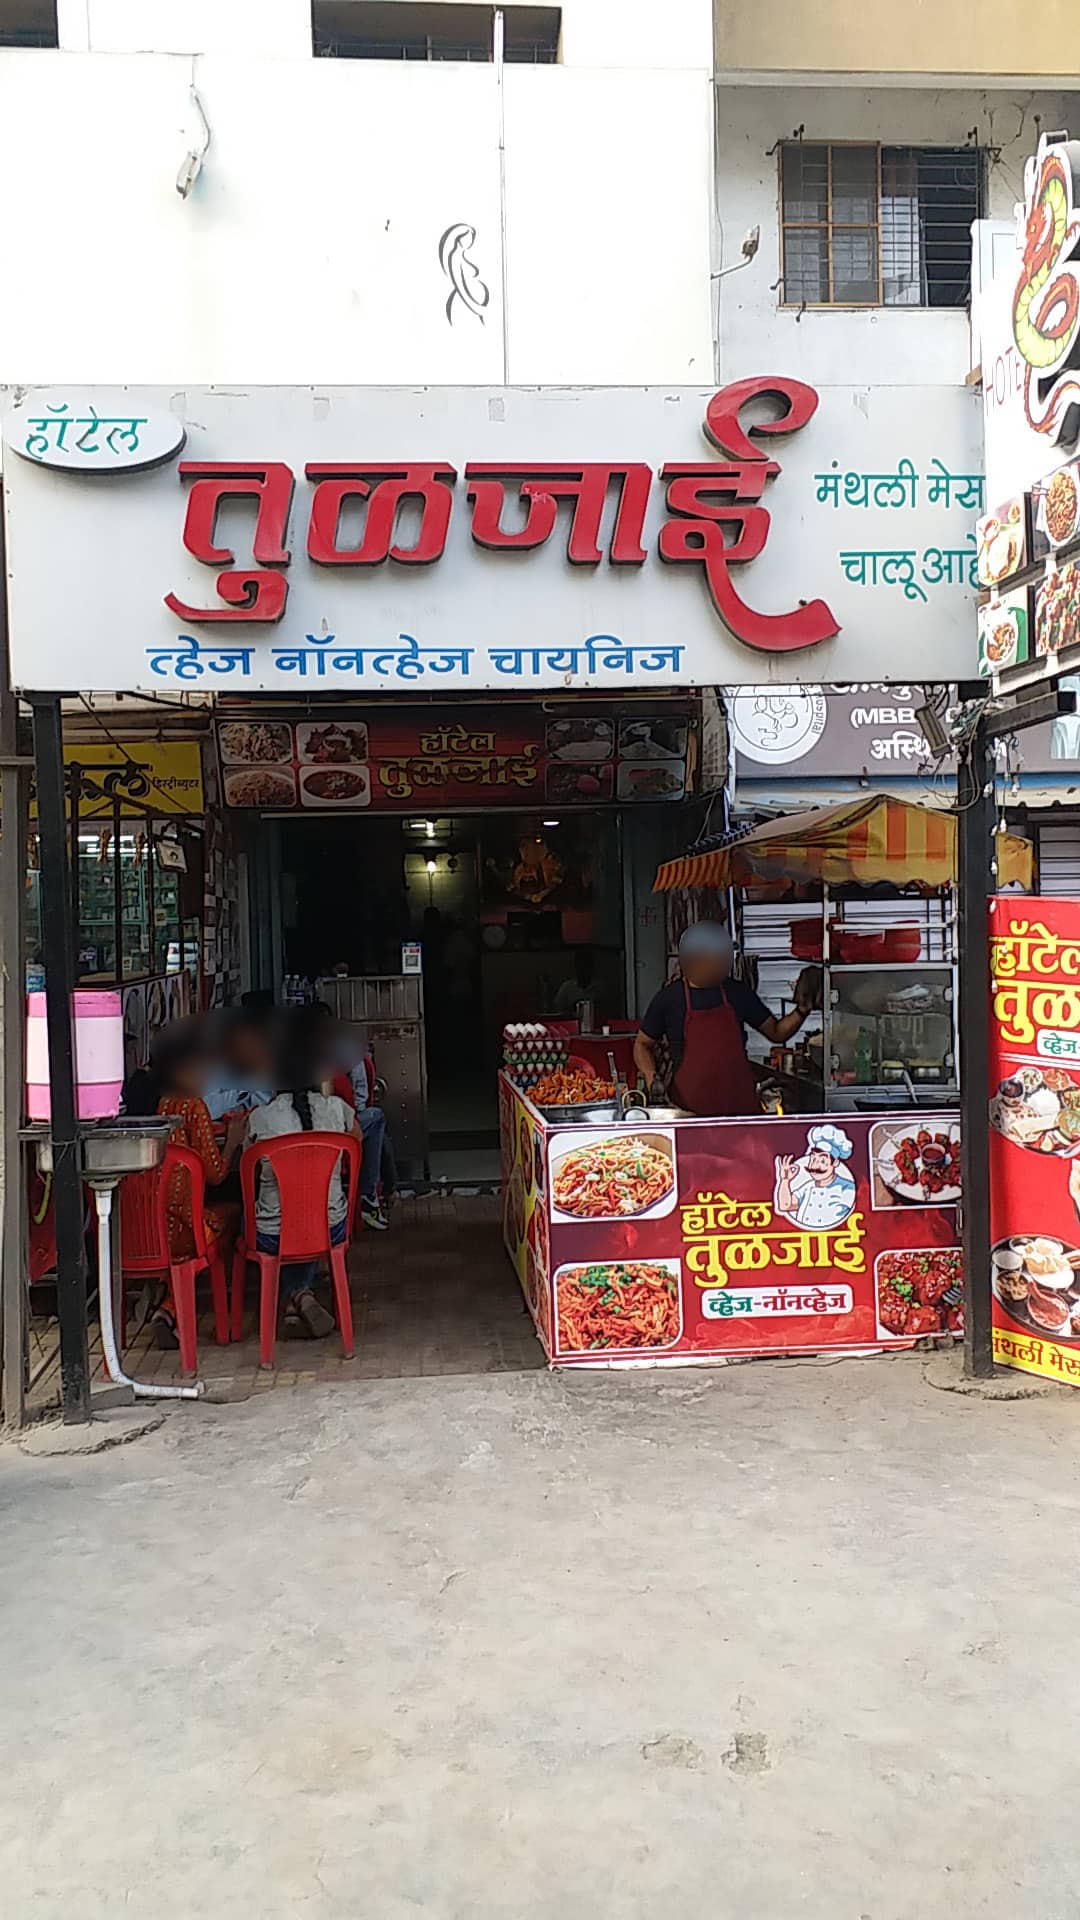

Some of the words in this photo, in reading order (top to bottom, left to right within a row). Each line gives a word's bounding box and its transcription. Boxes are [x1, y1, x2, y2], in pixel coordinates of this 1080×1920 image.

[25, 404, 148, 460] हॉटेल
[814, 459, 920, 508] मंथली
[926, 459, 986, 508] मेस
[163, 376, 843, 652] तुळजाई
[840, 551, 928, 602] चालू
[487, 634, 686, 675] चायनिज
[419, 722, 496, 755] हॉटेल
[850, 707, 920, 728] (MBB
[376, 743, 540, 799] तुळजाई
[680, 1192, 772, 1234] हॉटेल
[682, 1212, 867, 1287] तुळजाई
